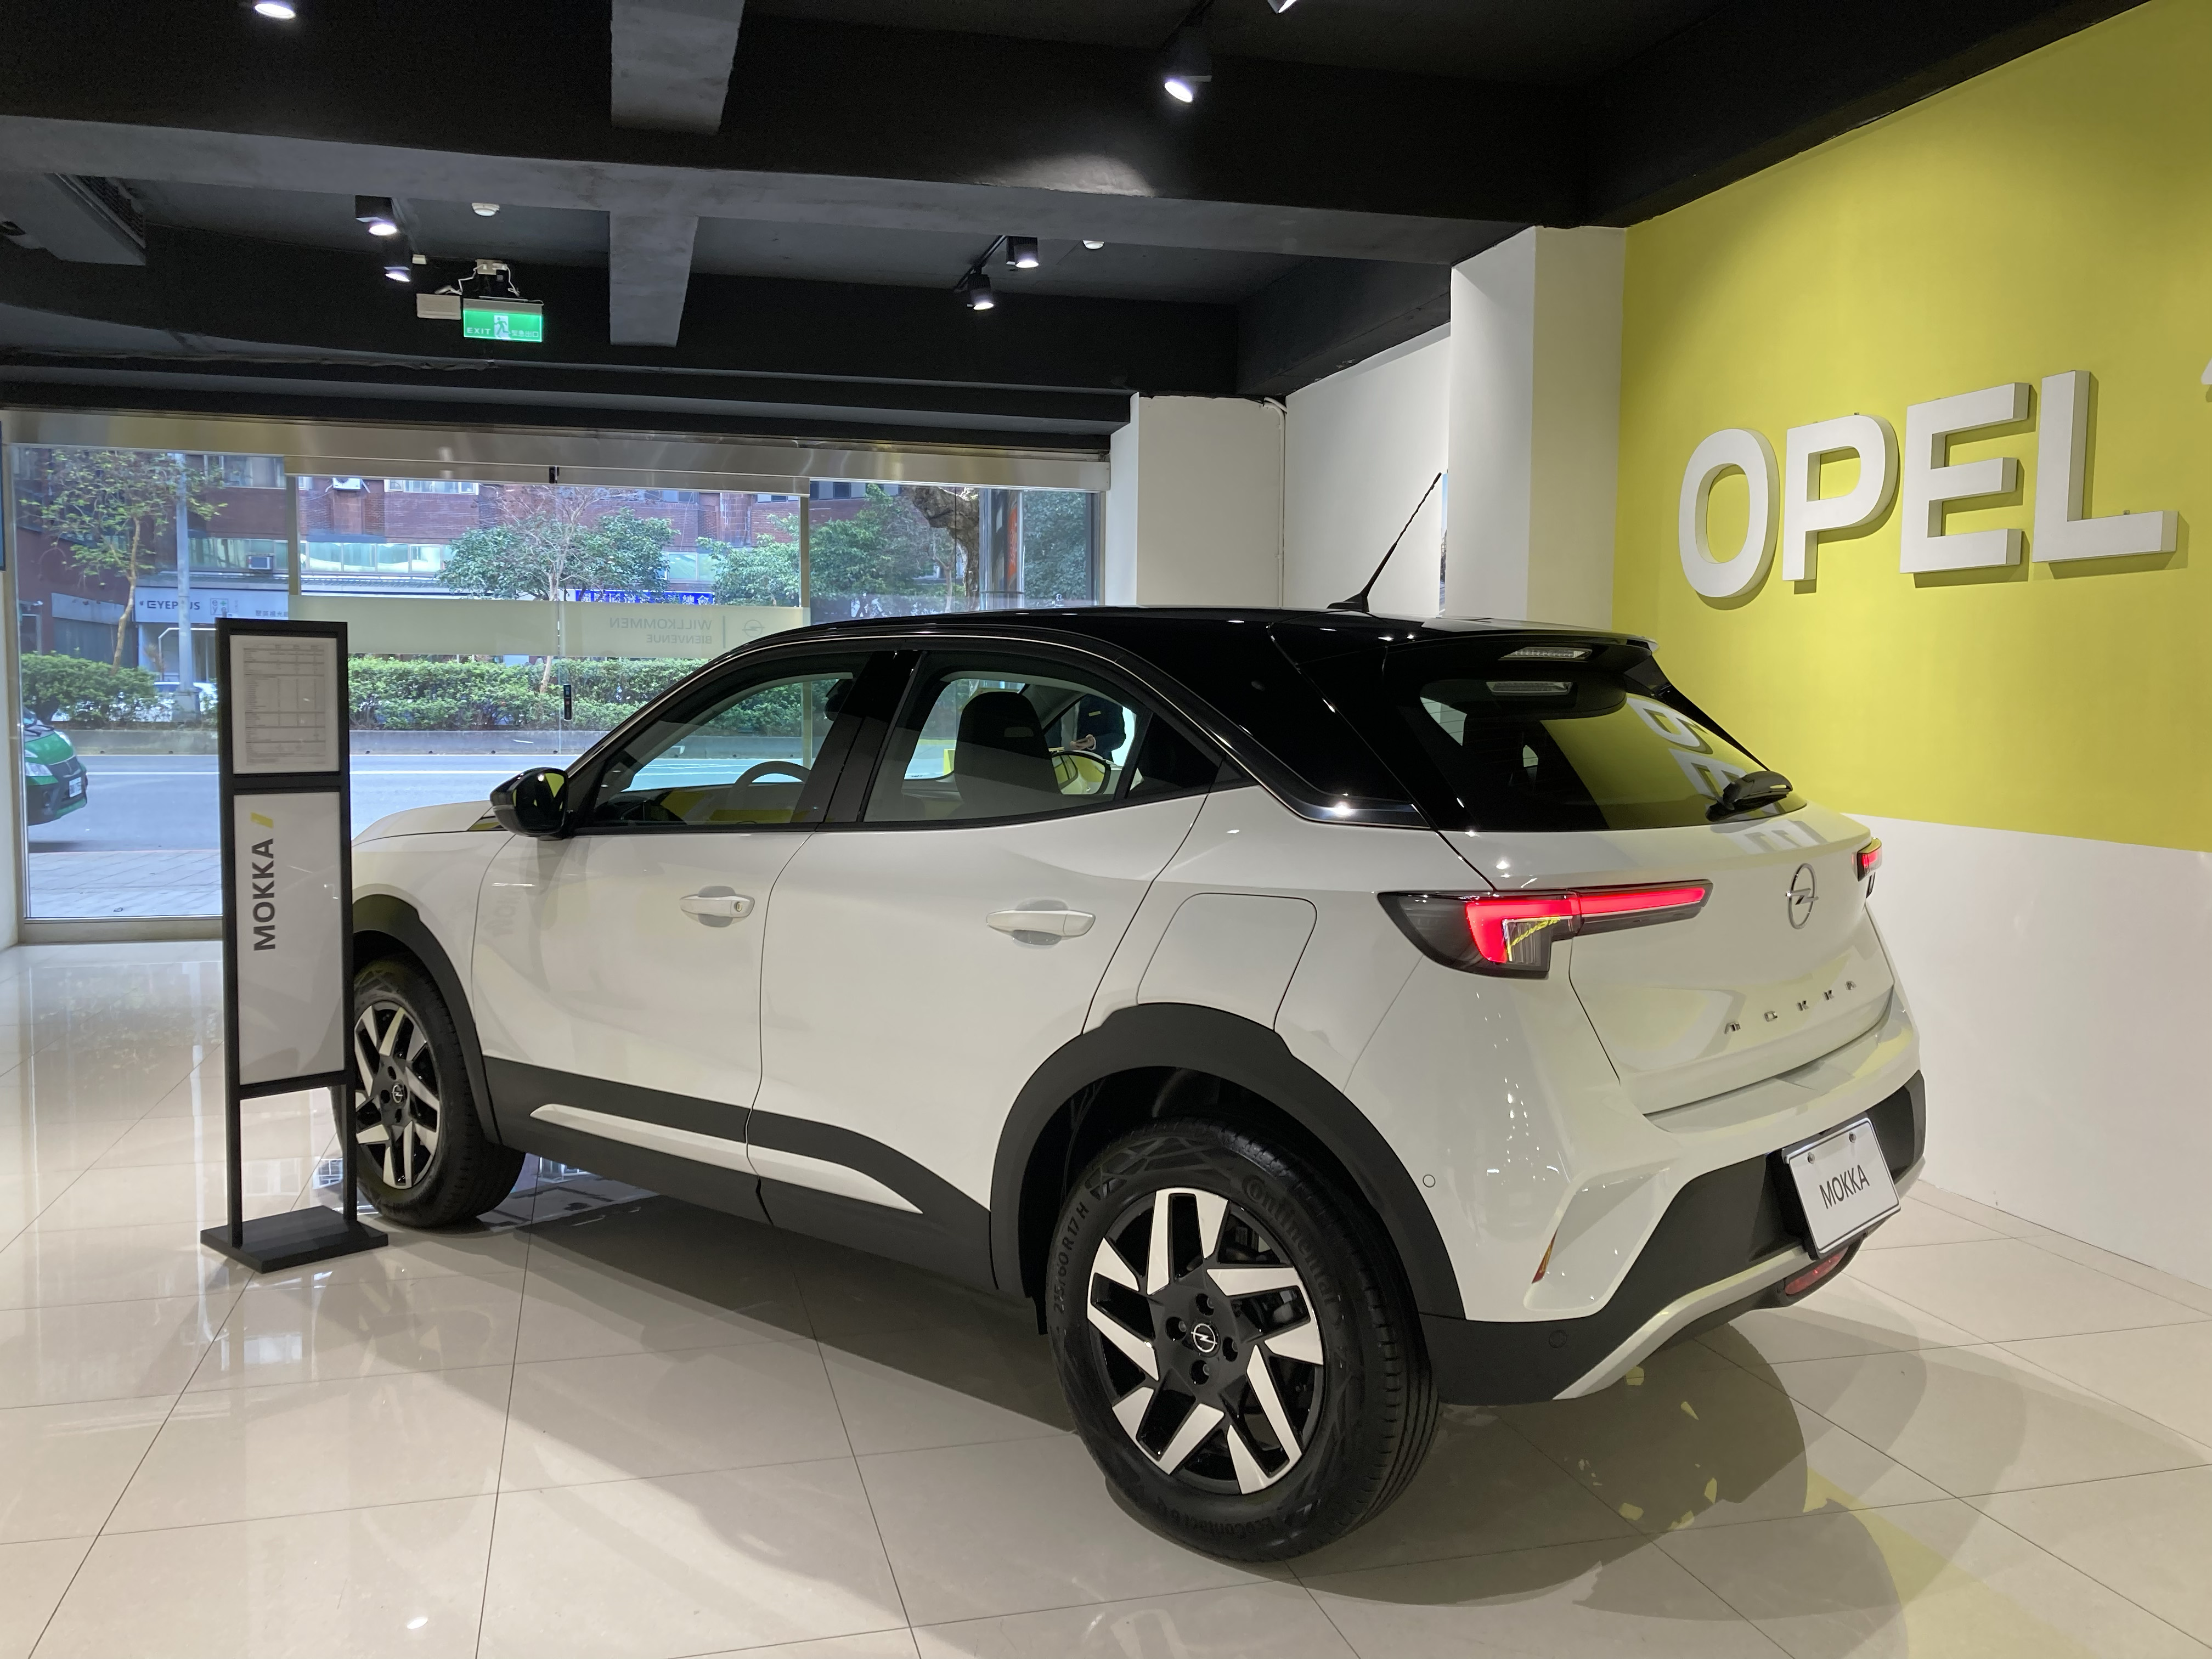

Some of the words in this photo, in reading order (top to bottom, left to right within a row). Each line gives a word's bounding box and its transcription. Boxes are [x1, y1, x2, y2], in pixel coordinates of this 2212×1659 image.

[1679, 370, 2178, 597] OPEL
[146, 600, 201, 610] EYEPS
[251, 838, 275, 951] MOKKA
[1819, 1165, 1870, 1209] MOKKA
